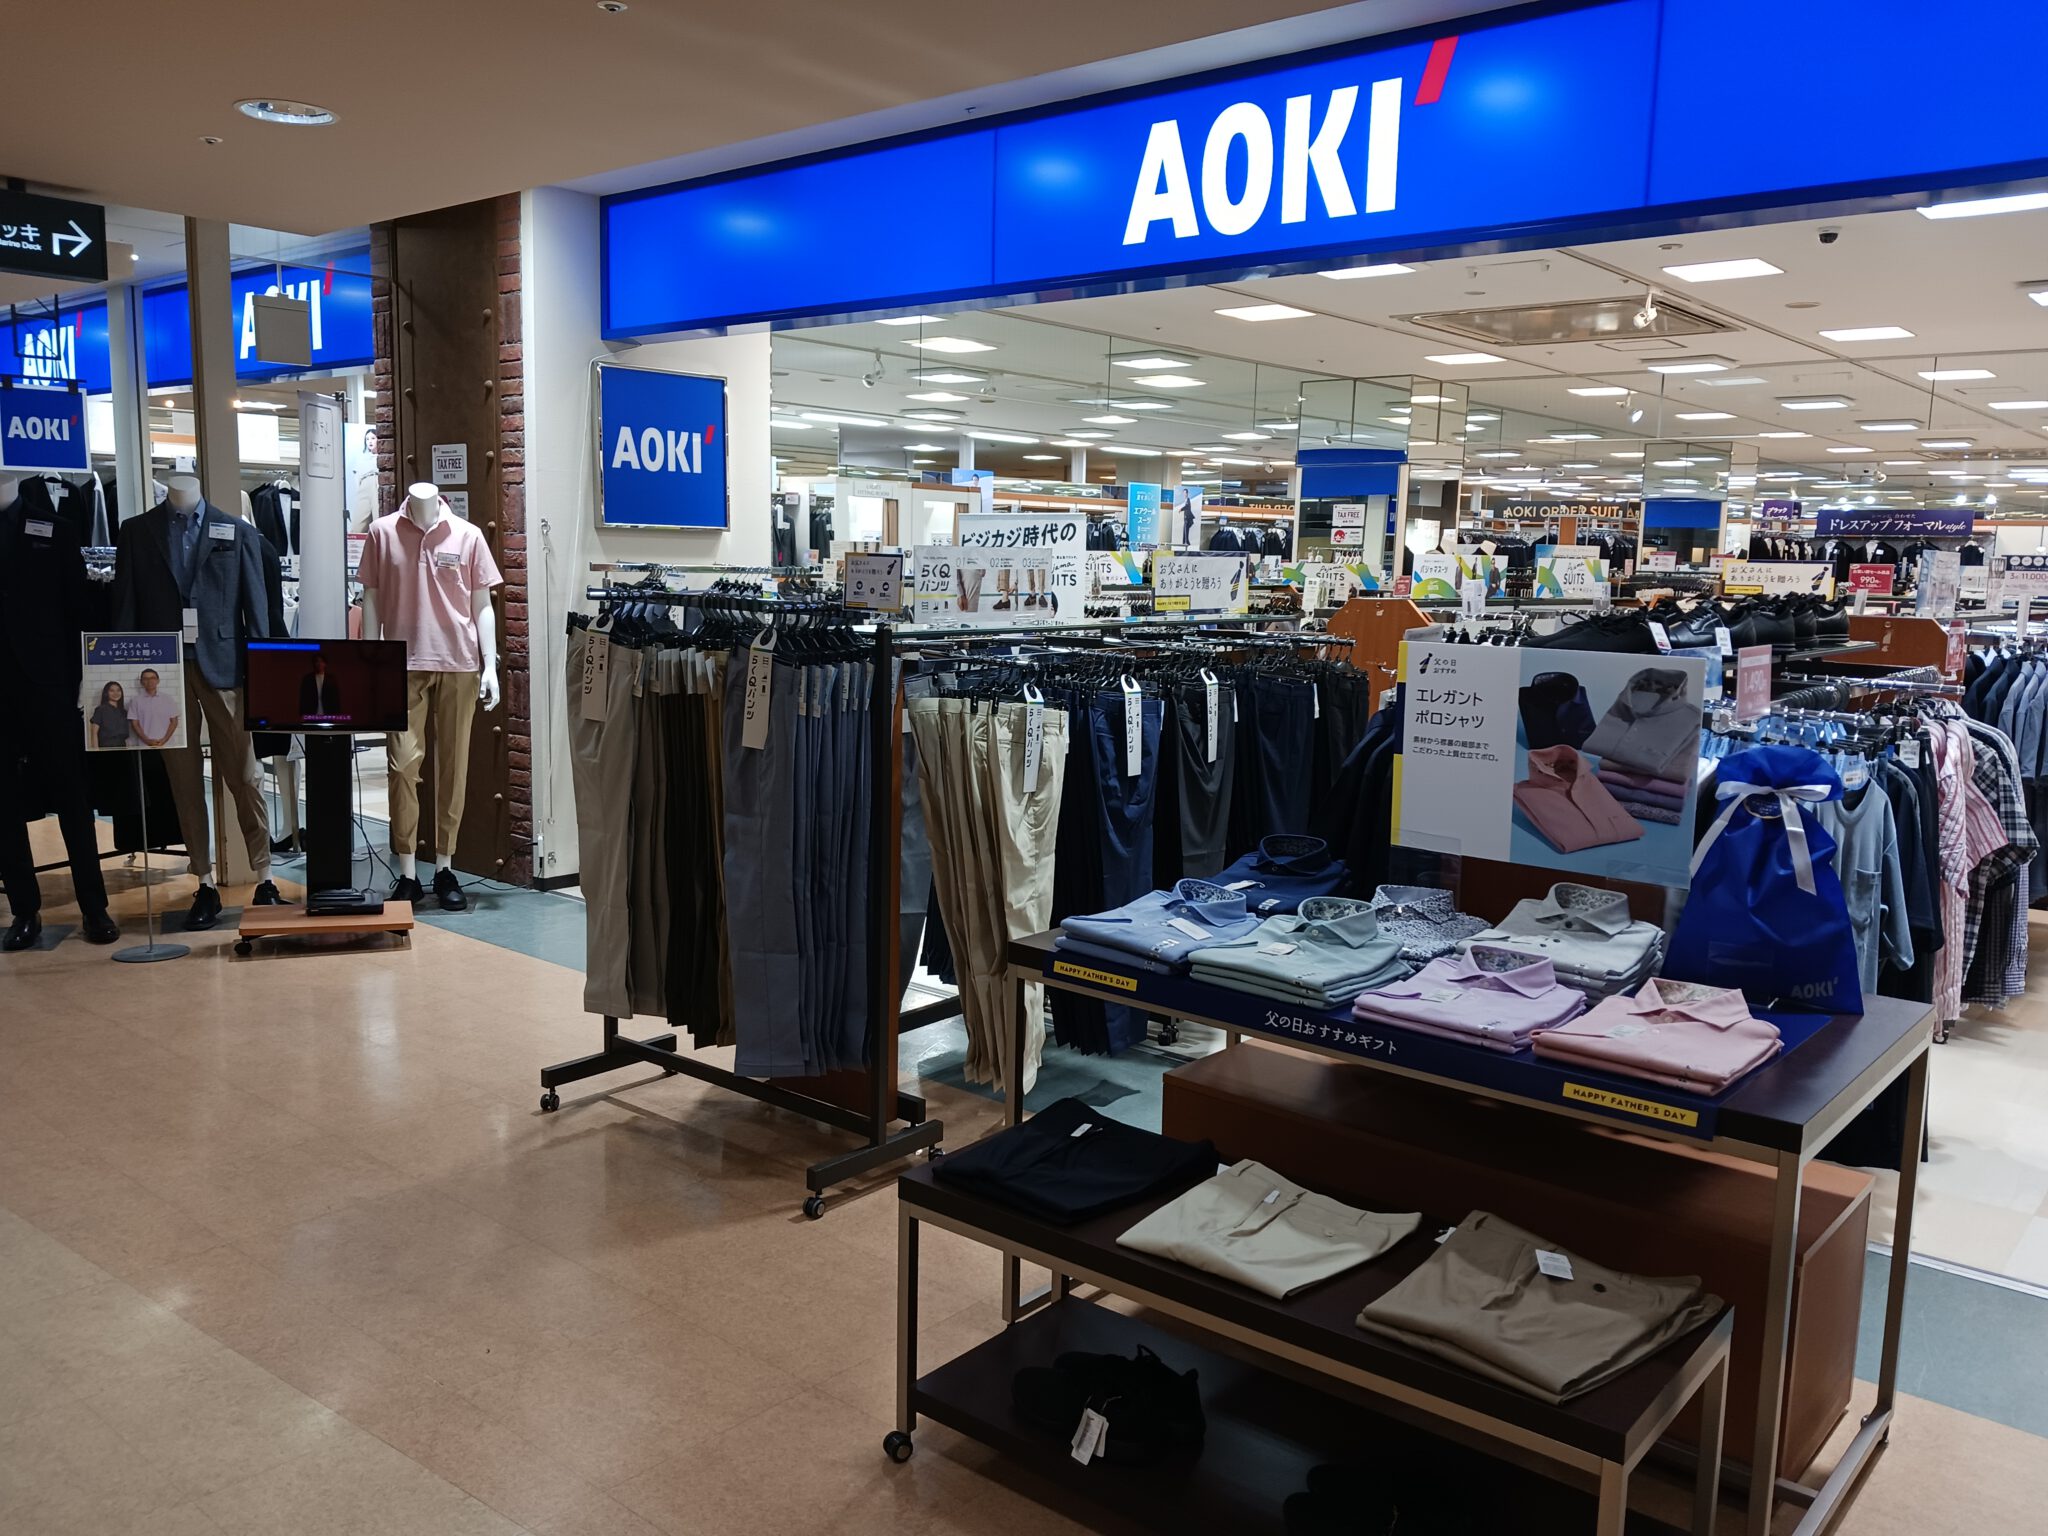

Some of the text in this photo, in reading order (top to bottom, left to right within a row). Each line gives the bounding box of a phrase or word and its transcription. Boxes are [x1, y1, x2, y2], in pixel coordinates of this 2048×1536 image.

[2, 224, 41, 242] ッキ
[22, 241, 42, 251] Deck
[240, 280, 322, 359] AI
[7, 416, 70, 441] AOKI
[612, 426, 702, 474] AOKI
[437, 457, 462, 470] TAX FREE
[1505, 506, 1536, 517] AOKI
[1540, 505, 1587, 517] ORDER
[1590, 506, 1620, 517] SUIT
[1829, 518, 1892, 531] ドレスアップ
[1894, 520, 1945, 531] フォーマル
[961, 522, 1077, 548] ビジカジ時代の
[990, 558, 999, 568] 02
[1022, 558, 1032, 568] 03
[1160, 562, 1197, 575] お父さんに
[921, 563, 951, 578] らくQ
[1731, 566, 1772, 574] お父さんに
[1051, 573, 1077, 586] ITS
[1160, 576, 1222, 590] ありがとうを贈ろう
[1563, 573, 1585, 585] SUITS
[920, 580, 949, 592] パンツ
[1434, 658, 1457, 666] 父の日
[1416, 689, 1483, 706] エレガント
[1415, 710, 1484, 729] ポロシャツ
[1059, 965, 1131, 988] HAPPY FATHER'S DAY
[1265, 1010, 1398, 1055] 父の日おすすめギフト
[1572, 1088, 1687, 1122] HAPPY FATHER'S DAY
